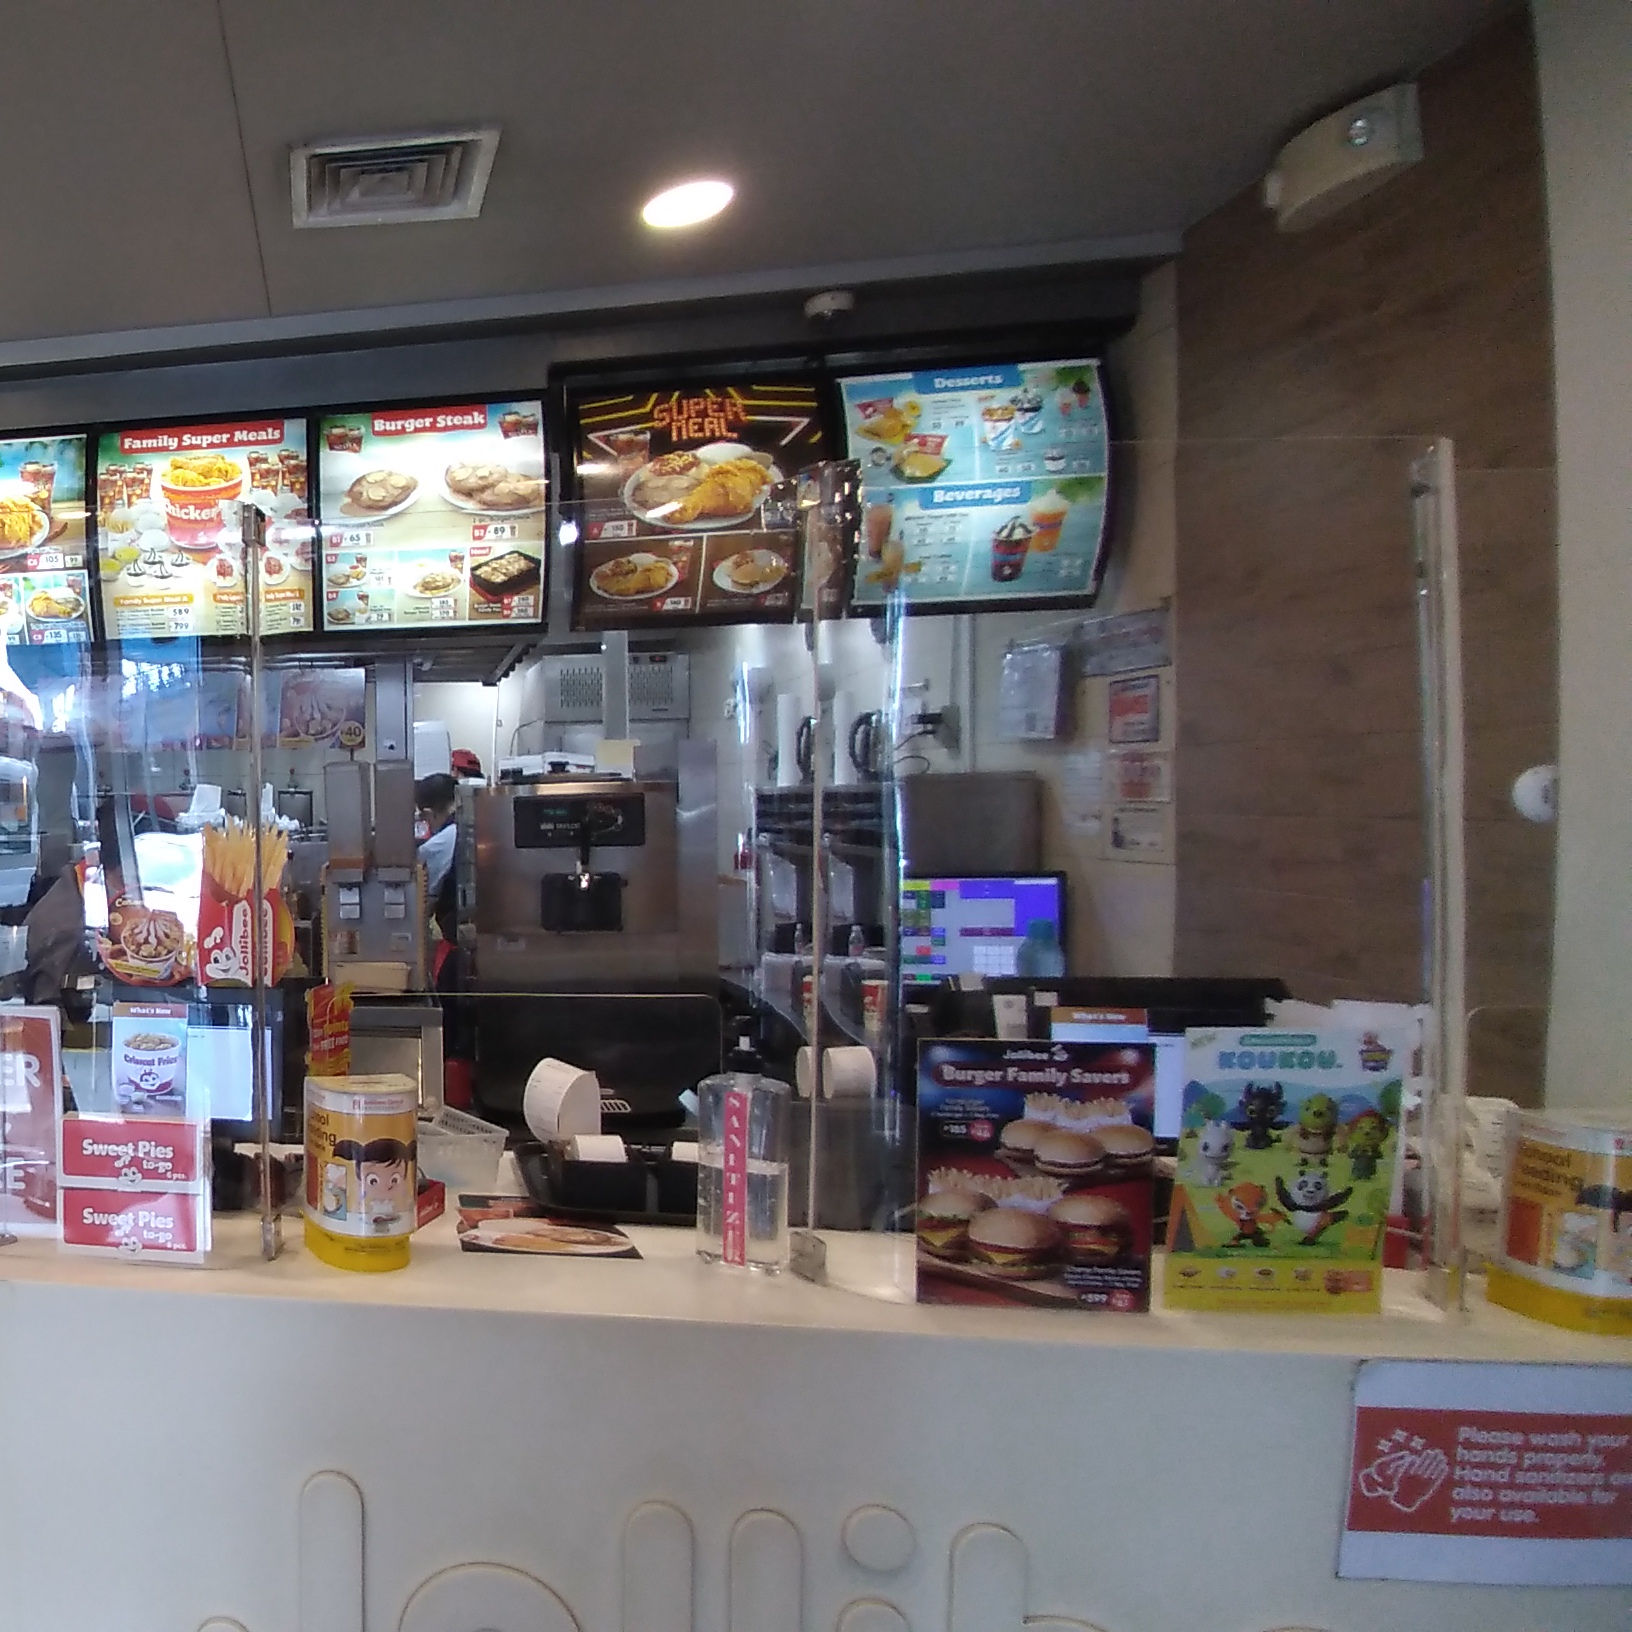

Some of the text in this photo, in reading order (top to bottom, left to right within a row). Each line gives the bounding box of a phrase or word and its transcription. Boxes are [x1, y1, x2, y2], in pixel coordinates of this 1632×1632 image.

[934, 374, 1003, 389] Desserts
[374, 412, 485, 432] Burger Steak
[653, 398, 747, 428] SUPER
[124, 427, 281, 450] Family Super Meals
[671, 417, 738, 442] MEAL
[932, 486, 1021, 503] Beverages
[174, 622, 189, 630] 799
[239, 907, 249, 976] Jollibee
[941, 1064, 1130, 1087] Burger Family Savers
[82, 1139, 174, 1158] Sweet Pies
[143, 1160, 172, 1173] to-go
[82, 1208, 174, 1228] Sweet Pies
[143, 1229, 172, 1243] to-go
[1457, 1426, 1630, 1455] Please wash your
[1455, 1445, 1606, 1469] hands properly.
[1454, 1465, 1632, 1487] Hand sanitizers ar
[1452, 1486, 1619, 1505] also available for
[1450, 1506, 1539, 1523] your use.
